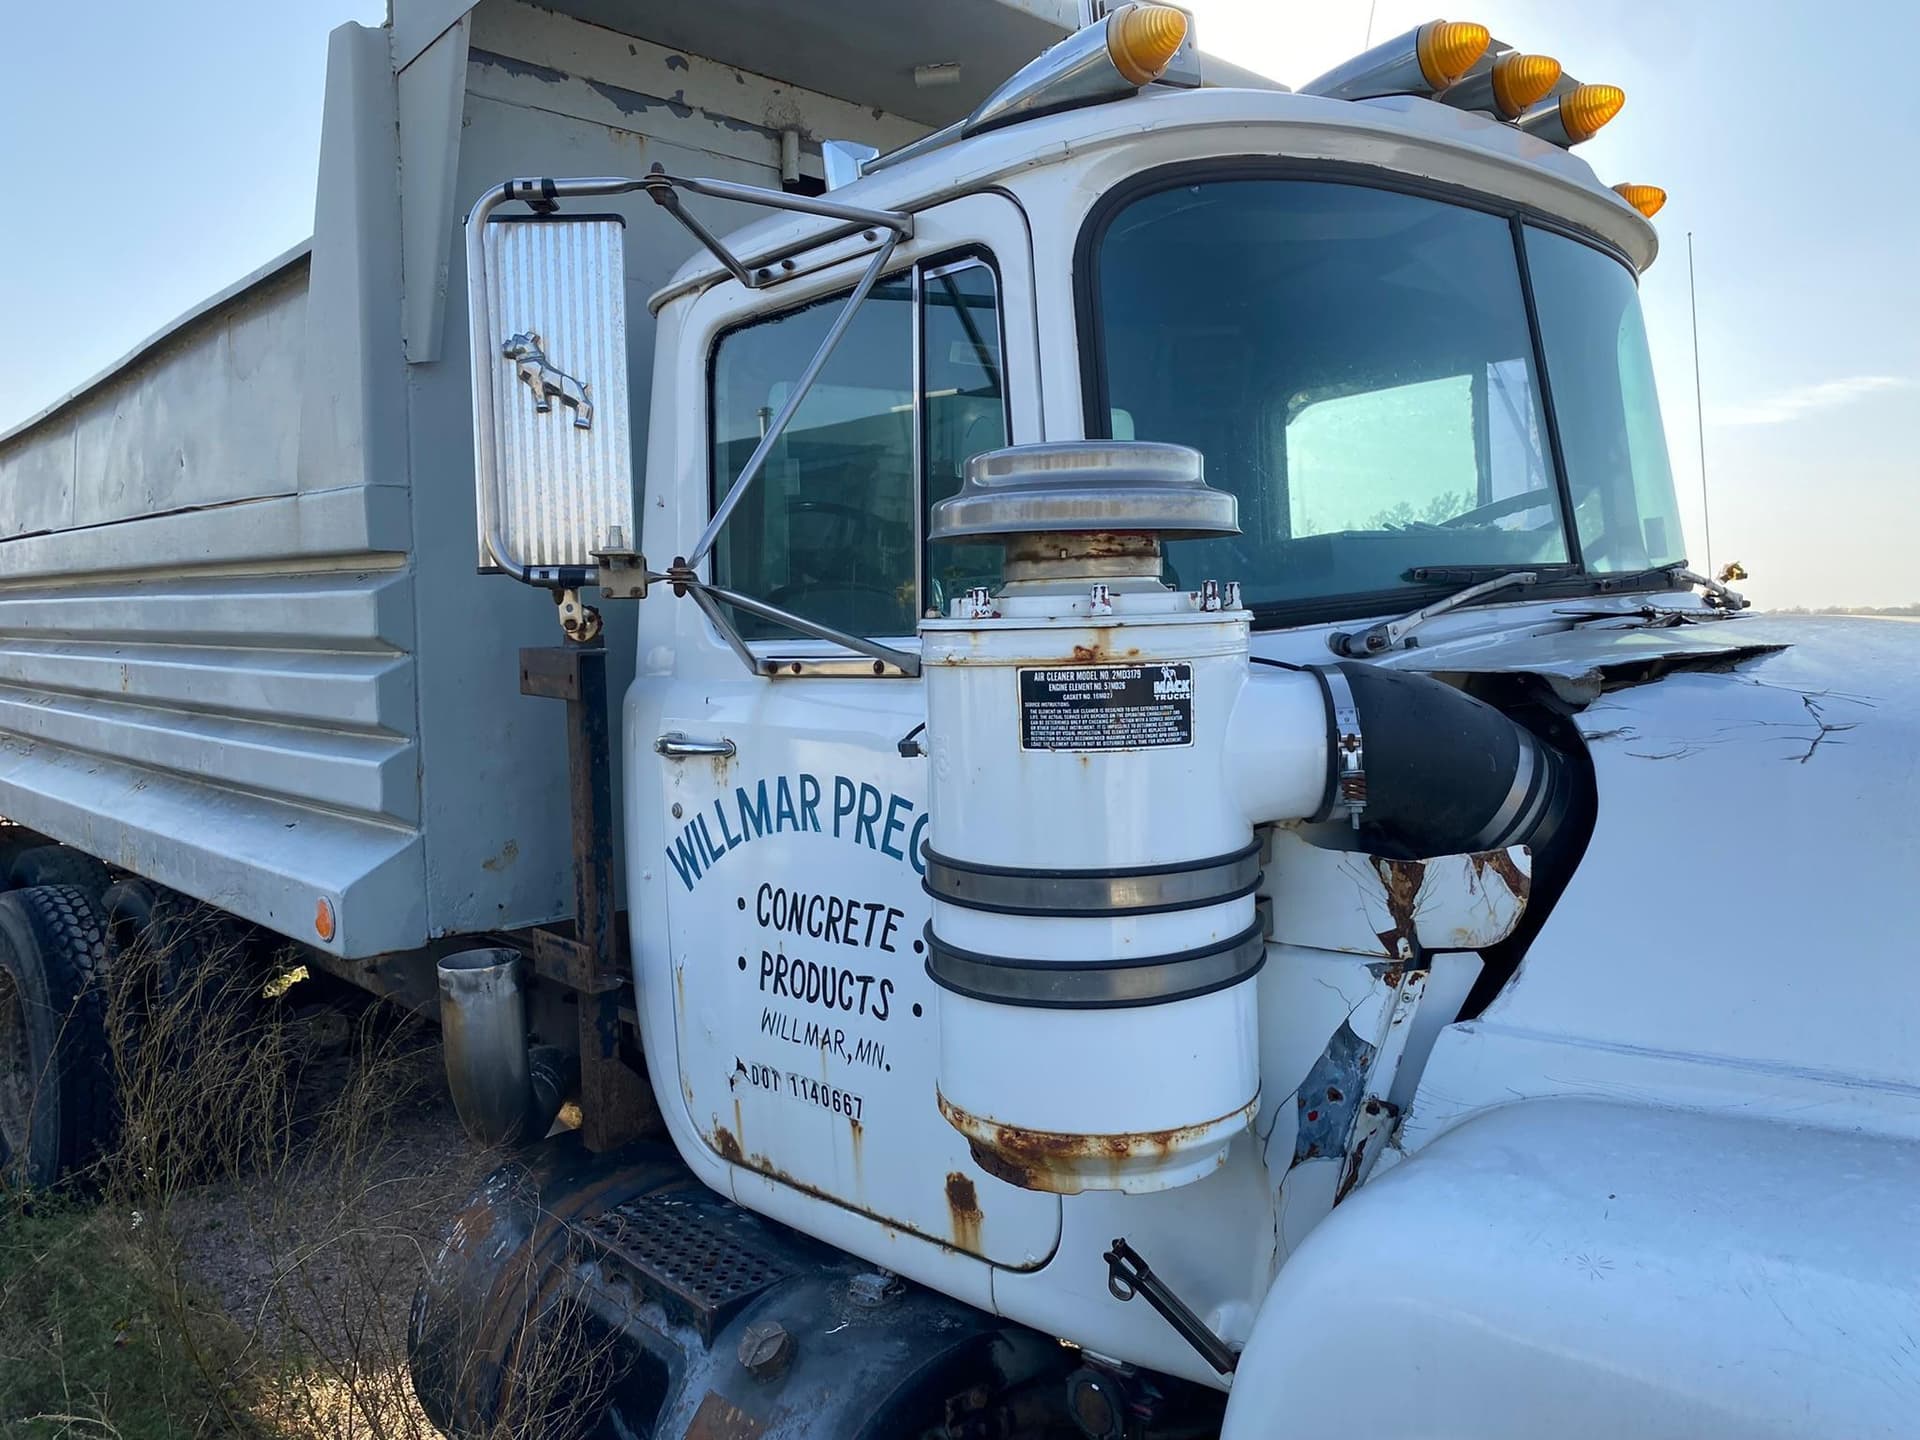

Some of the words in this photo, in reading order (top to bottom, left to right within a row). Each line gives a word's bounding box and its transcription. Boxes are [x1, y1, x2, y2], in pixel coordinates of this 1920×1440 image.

[1034, 672, 1044, 681] AIR
[1047, 671, 1075, 681] CLEANER
[1076, 671, 1097, 680] MODEL
[1049, 683, 1068, 691] ENGINE
[1069, 683, 1093, 691] ELEMENT
[1154, 680, 1190, 693] MACK
[665, 773, 822, 892] WILLMAR
[756, 882, 905, 953] CONCRETE
[759, 950, 895, 1021] PRODUCTS
[761, 1007, 852, 1066] WILLMAR,
[855, 1037, 891, 1072] MN.
[752, 1065, 780, 1092] DOT
[790, 1075, 863, 1120] 1140667
